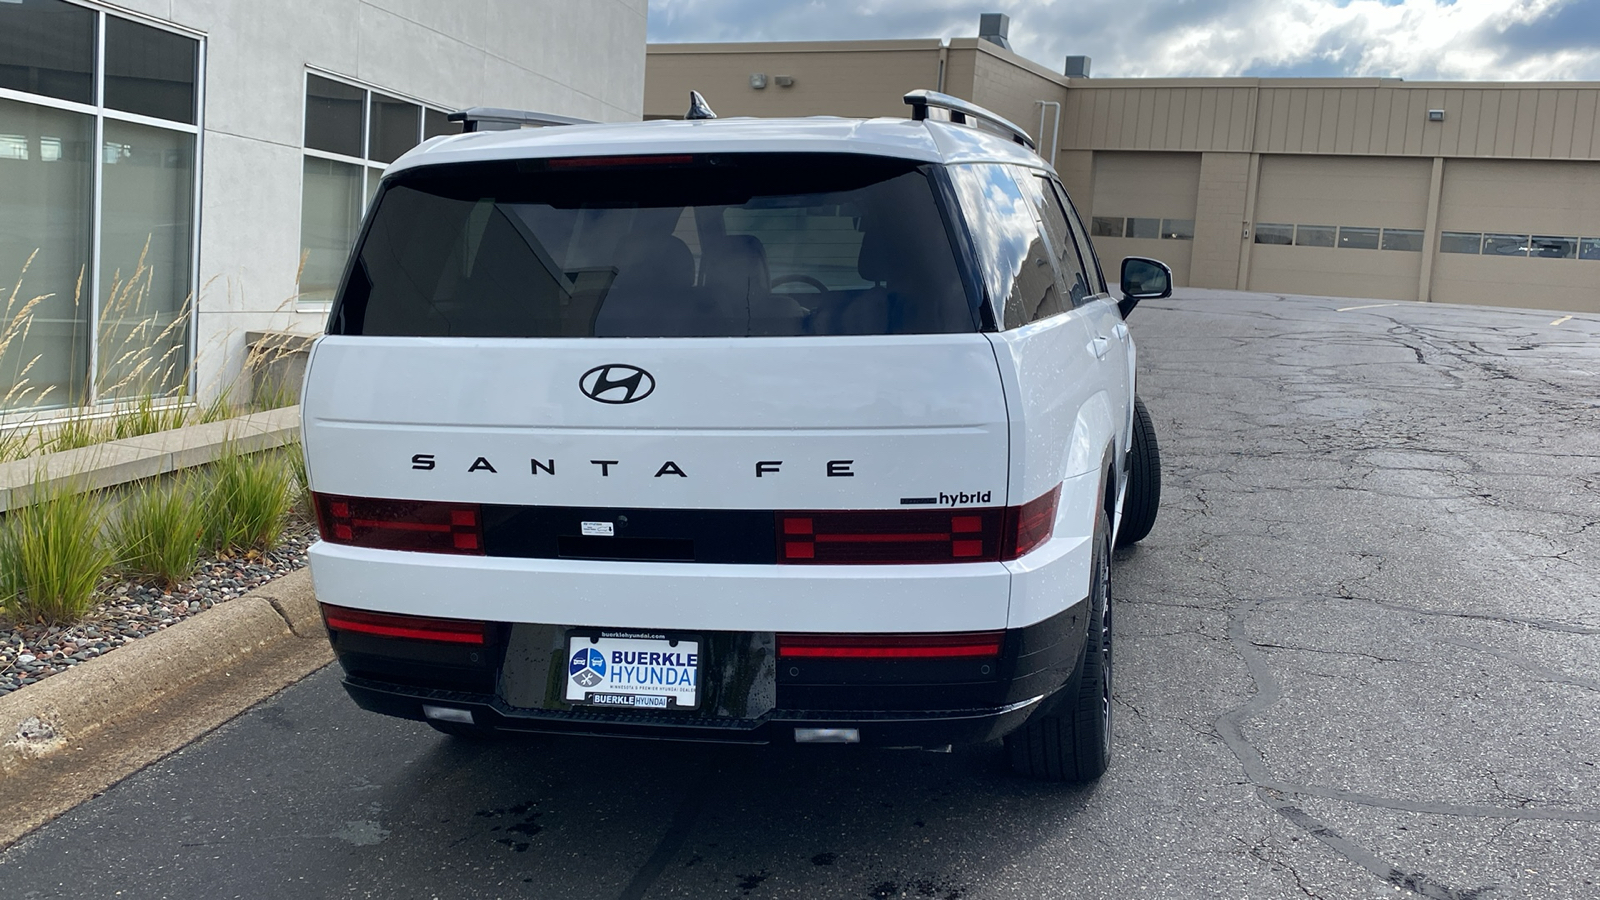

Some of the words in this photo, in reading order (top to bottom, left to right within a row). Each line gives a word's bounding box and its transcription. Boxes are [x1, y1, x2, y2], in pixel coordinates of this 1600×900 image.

[411, 453, 688, 477] SANTA
[755, 460, 854, 477] FE
[939, 491, 991, 507] hybrid
[611, 651, 697, 666] BUERKLE
[610, 666, 697, 686] HYUNDAI
[594, 695, 634, 705] BUERKLE
[635, 696, 666, 706] HYUNDAI
